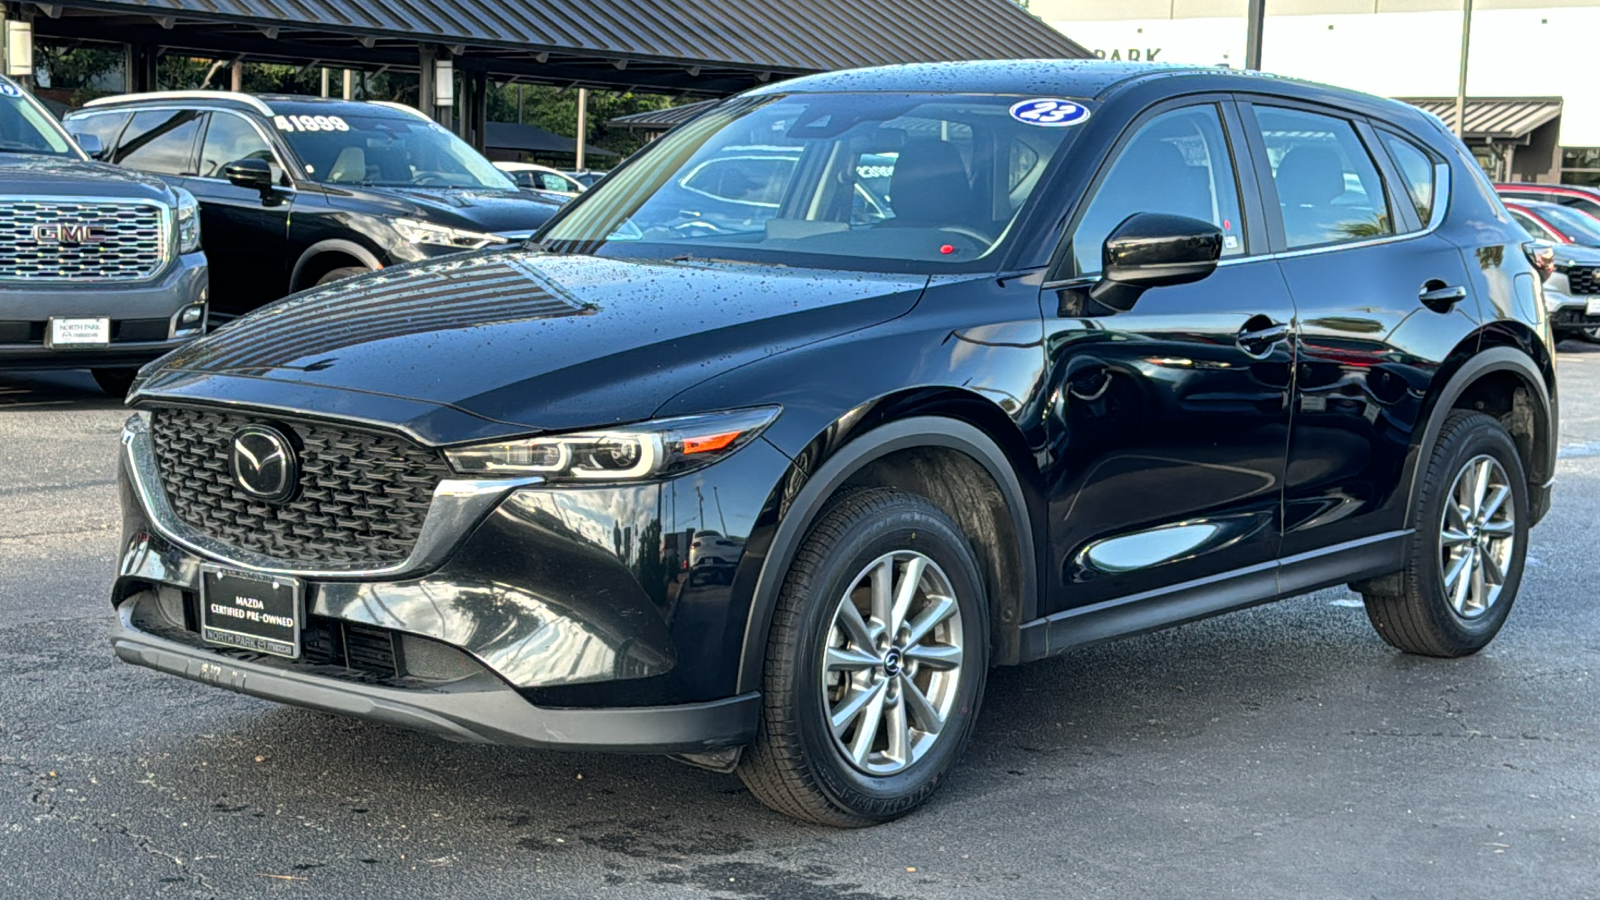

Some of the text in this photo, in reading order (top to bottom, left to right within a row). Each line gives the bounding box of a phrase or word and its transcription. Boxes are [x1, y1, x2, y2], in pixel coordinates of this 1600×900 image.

[1093, 48, 1161, 61] PARK
[1020, 102, 1076, 122] 23
[273, 114, 350, 132] 41999
[33, 223, 106, 243] GMC
[235, 596, 264, 610] MAZDA
[211, 603, 293, 628] CERTIFIED PRE-OWNED
[207, 630, 234, 643] NORTH
[235, 635, 256, 648] PARK
